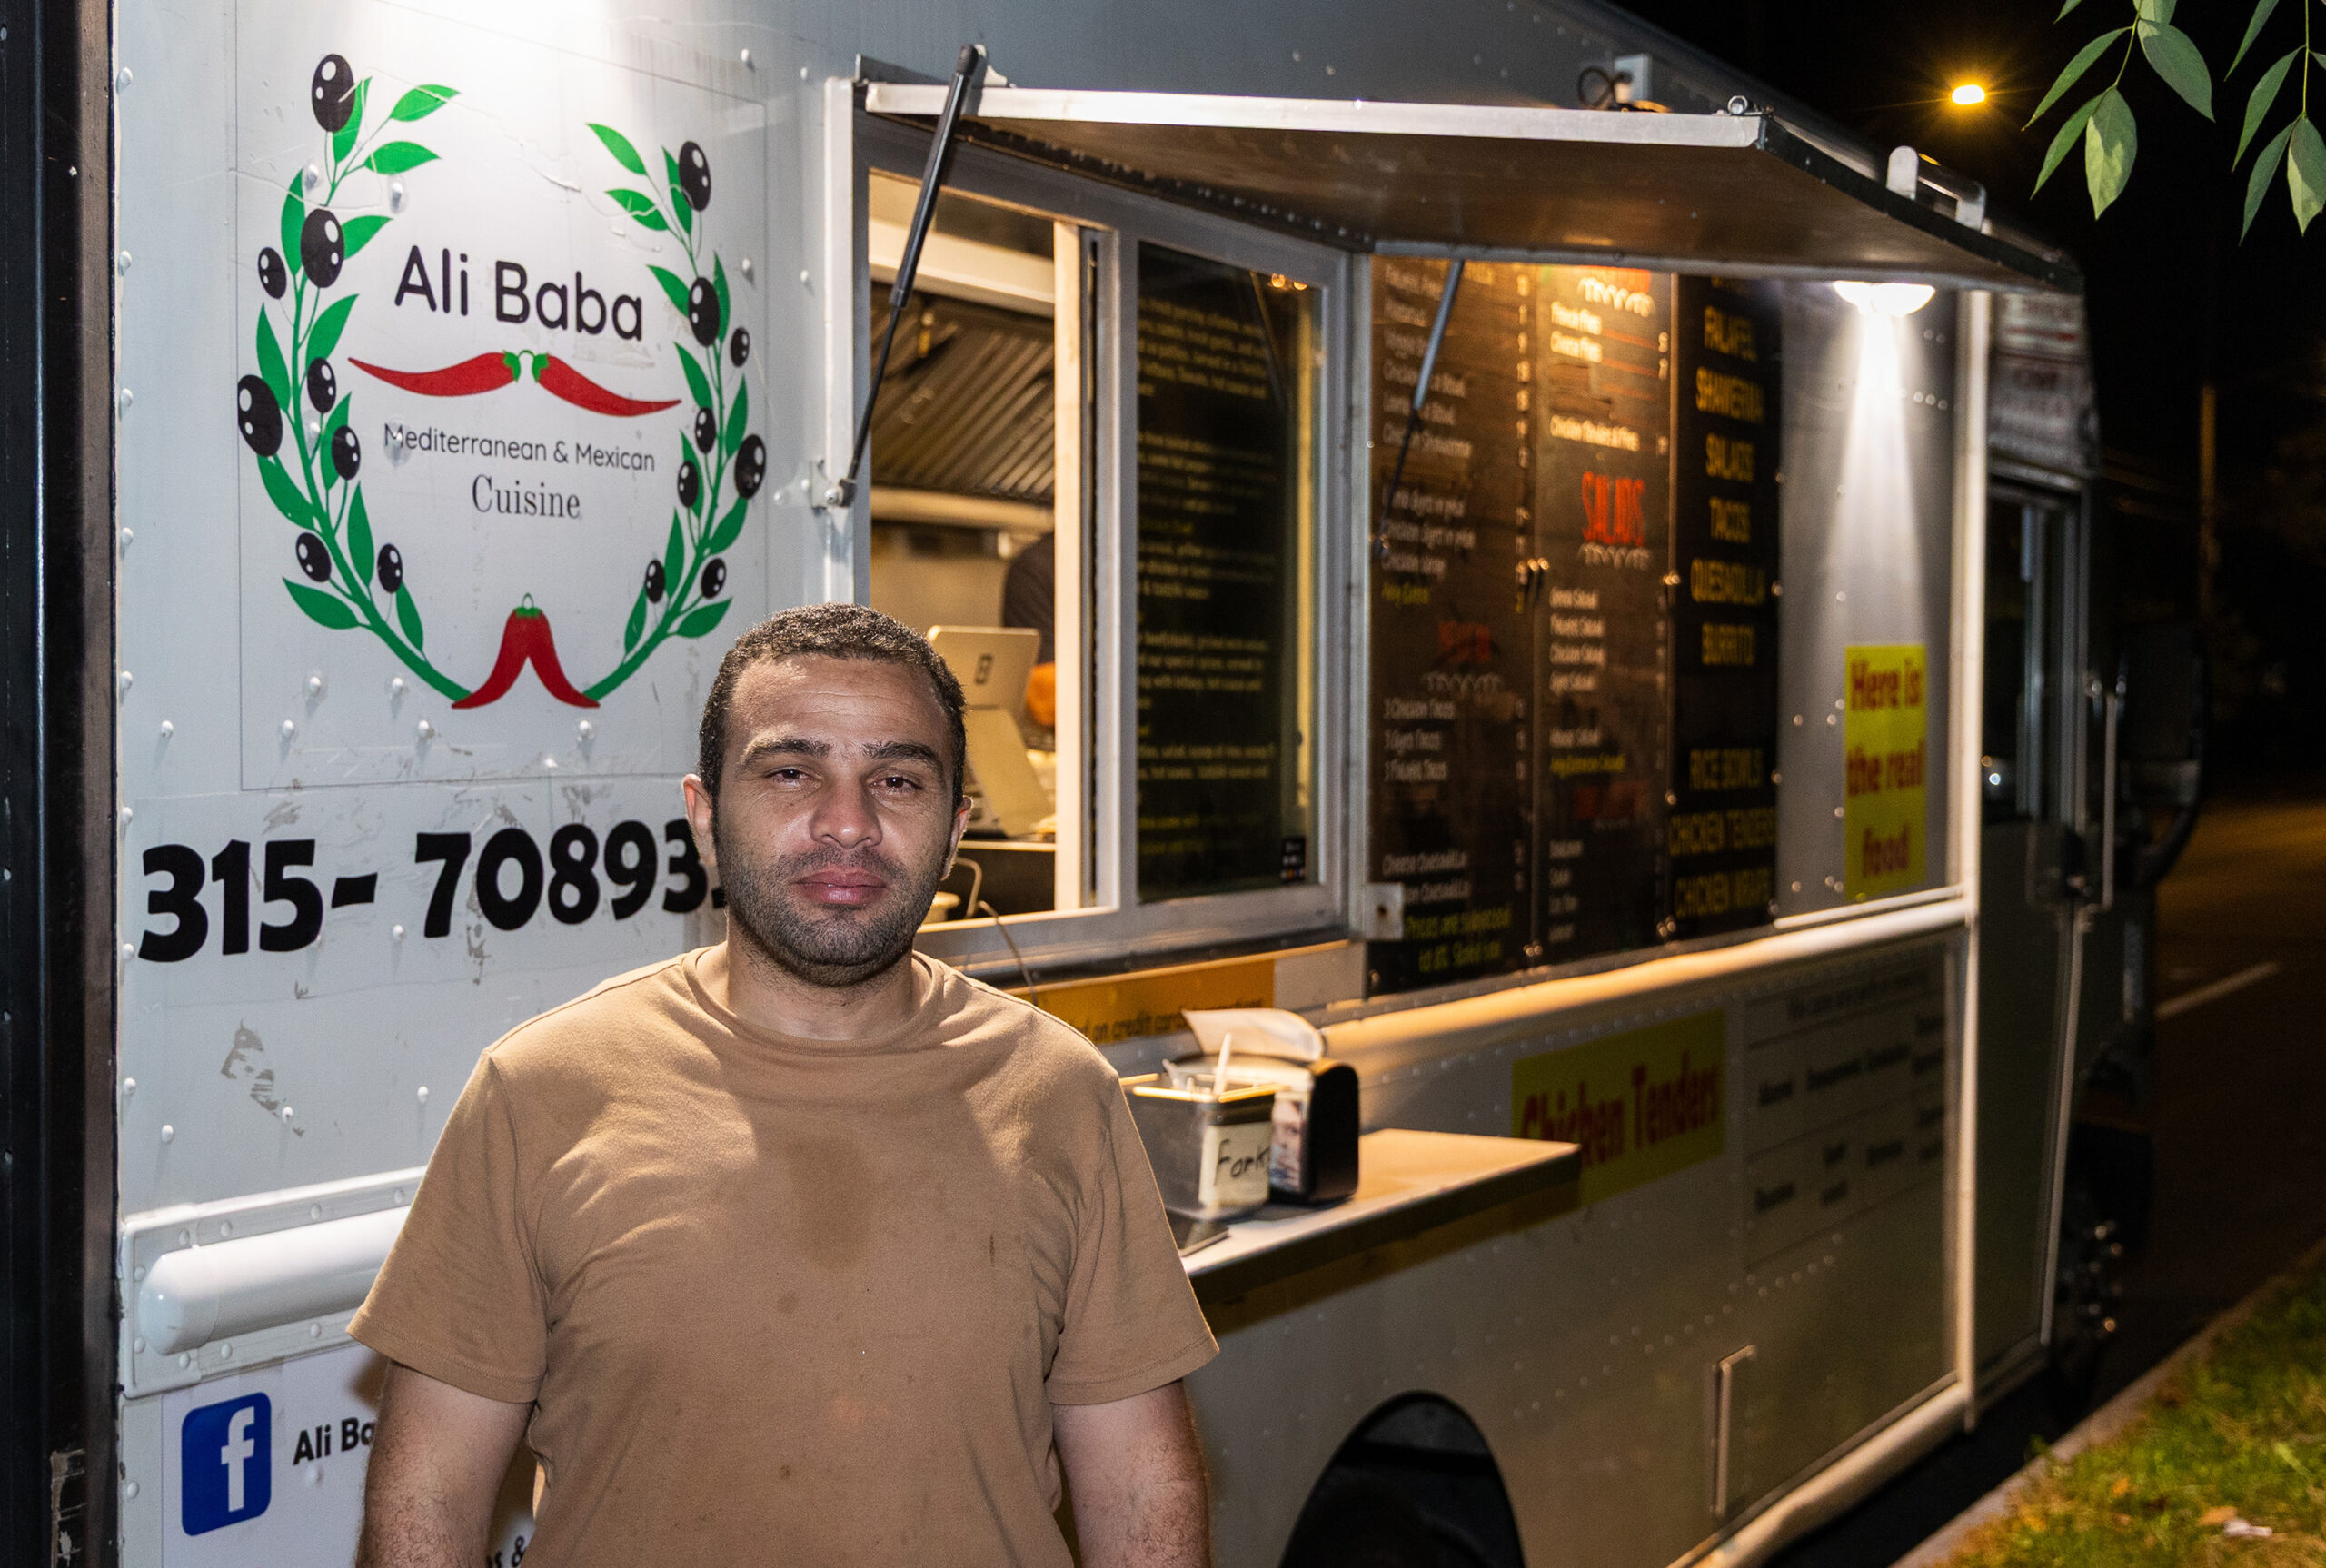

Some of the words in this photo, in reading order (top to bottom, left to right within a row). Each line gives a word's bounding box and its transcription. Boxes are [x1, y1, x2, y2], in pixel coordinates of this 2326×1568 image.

[394, 245, 468, 316] Ali
[495, 260, 642, 342] Baba
[383, 422, 547, 461] Mediterranean
[553, 440, 569, 464] &
[575, 442, 655, 471] Mexican
[472, 474, 582, 520] Cuisine
[138, 839, 378, 963] 315-
[292, 1424, 332, 1465] Ali
